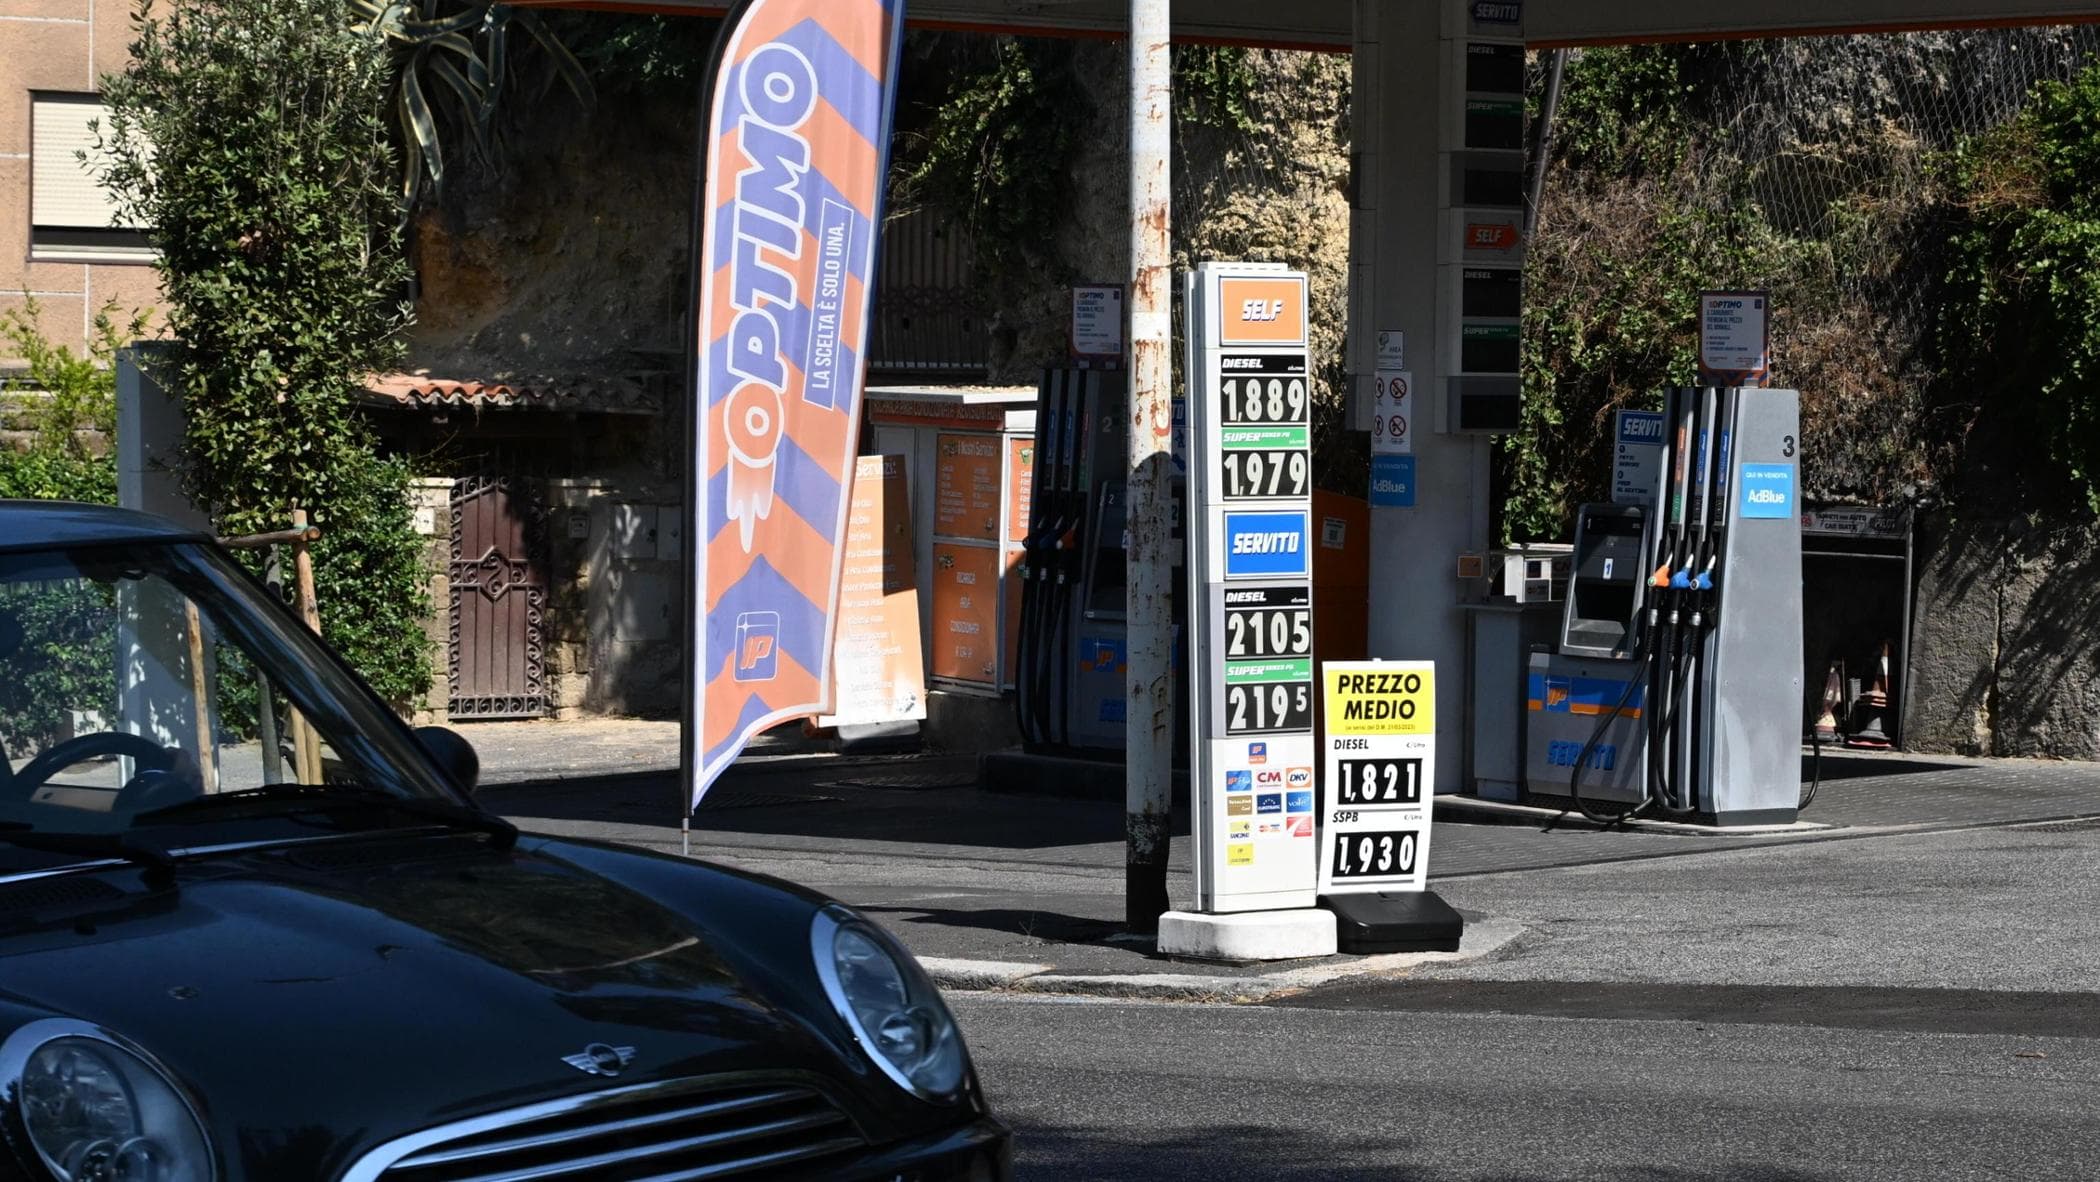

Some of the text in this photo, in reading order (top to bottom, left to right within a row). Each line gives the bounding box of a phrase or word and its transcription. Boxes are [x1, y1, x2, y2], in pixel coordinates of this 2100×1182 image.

[1475, 2, 1518, 20] SERVITO
[1474, 228, 1503, 244] SELF
[723, 42, 818, 468] OPTIMO
[1464, 271, 1492, 279] DIESEL
[812, 222, 846, 389] LA SCELTA È SOLO UNA.
[1242, 299, 1283, 321] SELF
[1463, 327, 1489, 335] SUPER
[1221, 358, 1264, 369] DIESEL
[1221, 379, 1305, 422] 1,889
[1102, 416, 1113, 433] 2
[1623, 417, 1663, 437] SERVIT
[1222, 431, 1261, 442] SUPER
[1783, 435, 1795, 457] 3
[1223, 452, 1307, 496] 1,979
[1372, 479, 1406, 493] AdBlue
[1747, 488, 1785, 504] AdBlue
[1232, 531, 1300, 555] SERVITO
[1606, 563, 1611, 576] 1
[1225, 591, 1267, 603] DIESEL
[1227, 611, 1310, 655] 2105
[1226, 664, 1265, 676] SUPER
[1337, 673, 1422, 694] PREZZO
[1343, 699, 1416, 720] MEDIO
[1334, 739, 1370, 750] DIESEL
[1257, 771, 1282, 783] CM
[1290, 773, 1308, 782] DKV
[1342, 763, 1417, 802] 1,821
[1332, 811, 1359, 823] SSPB
[1339, 834, 1415, 875] 1,930
